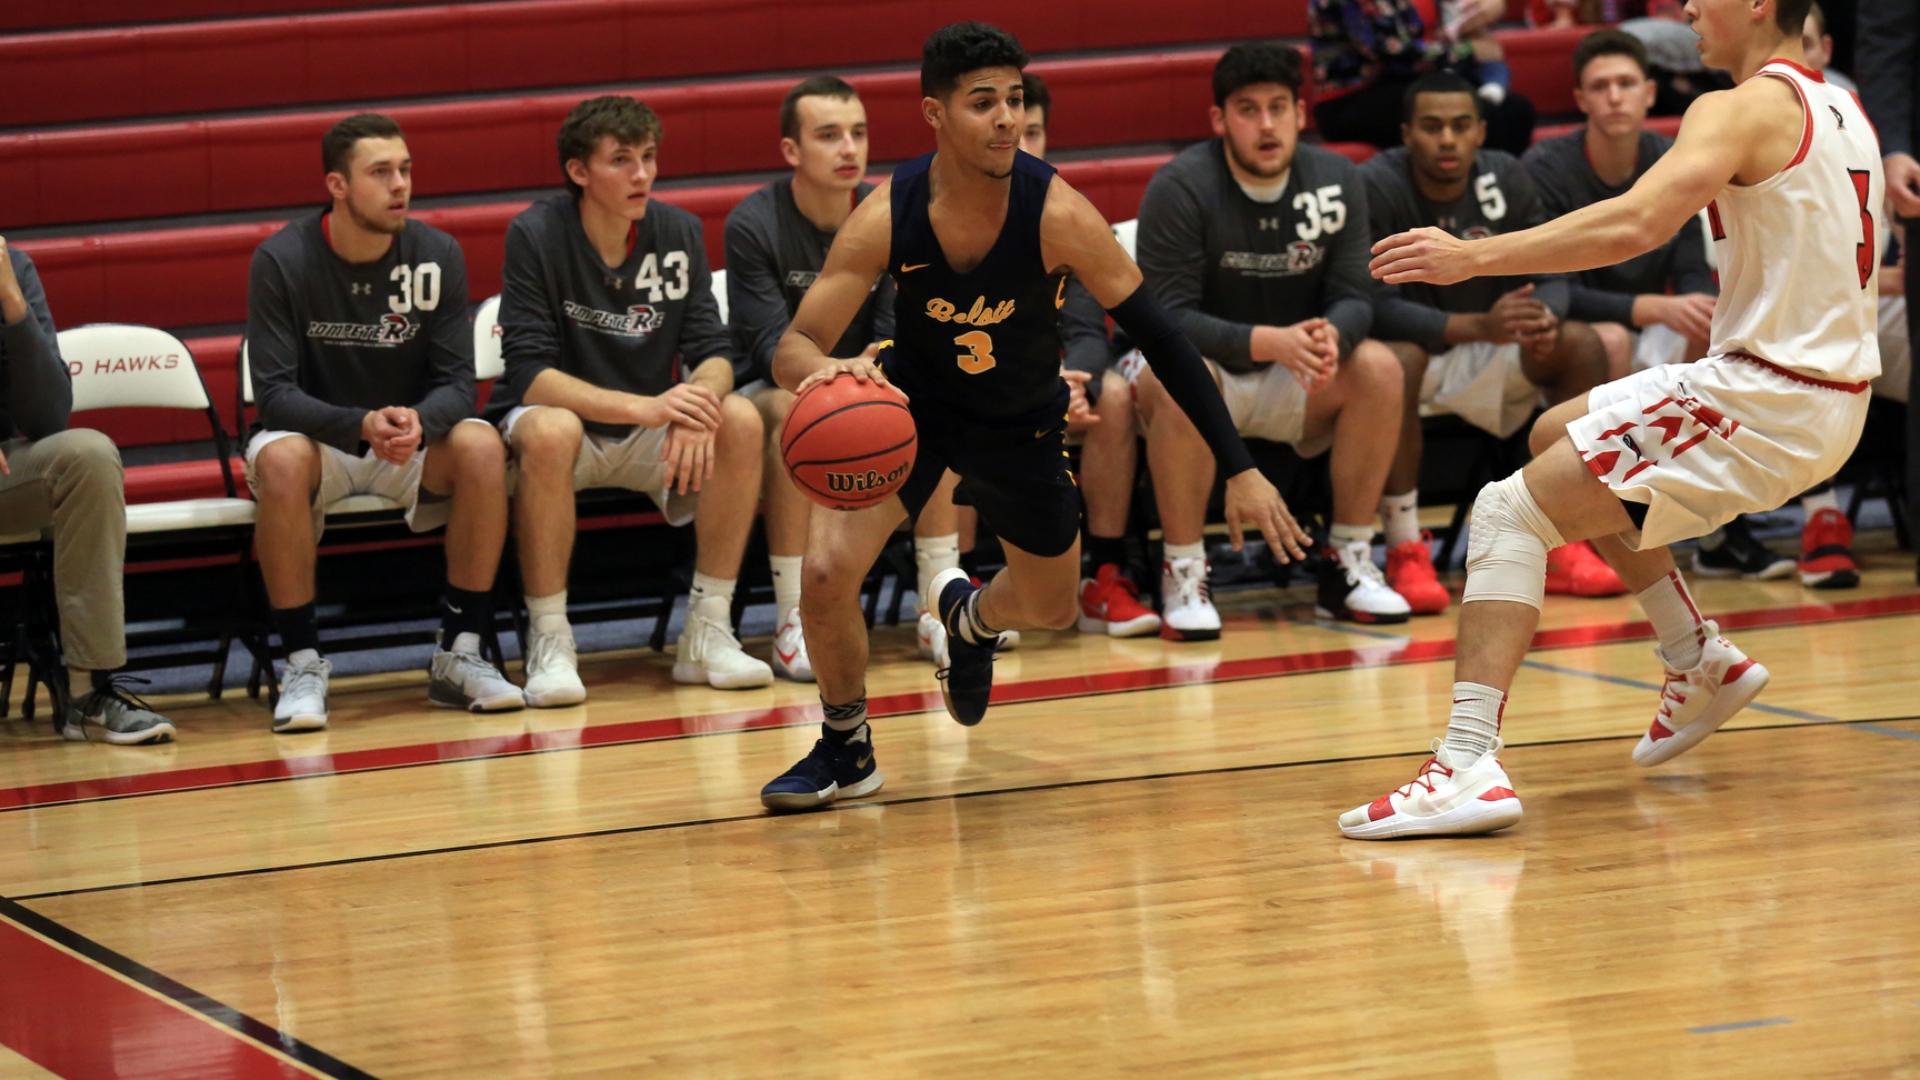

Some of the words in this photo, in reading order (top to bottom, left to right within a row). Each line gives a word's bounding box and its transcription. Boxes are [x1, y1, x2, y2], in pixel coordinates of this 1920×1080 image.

[1292, 184, 1347, 241] 35
[1474, 171, 1507, 221] 5
[388, 261, 441, 314] 30
[635, 250, 689, 303] 43
[925, 295, 1016, 327] Beloit
[94, 354, 179, 375] HAWKS
[953, 330, 996, 375] 3
[826, 461, 909, 492] Wilson
